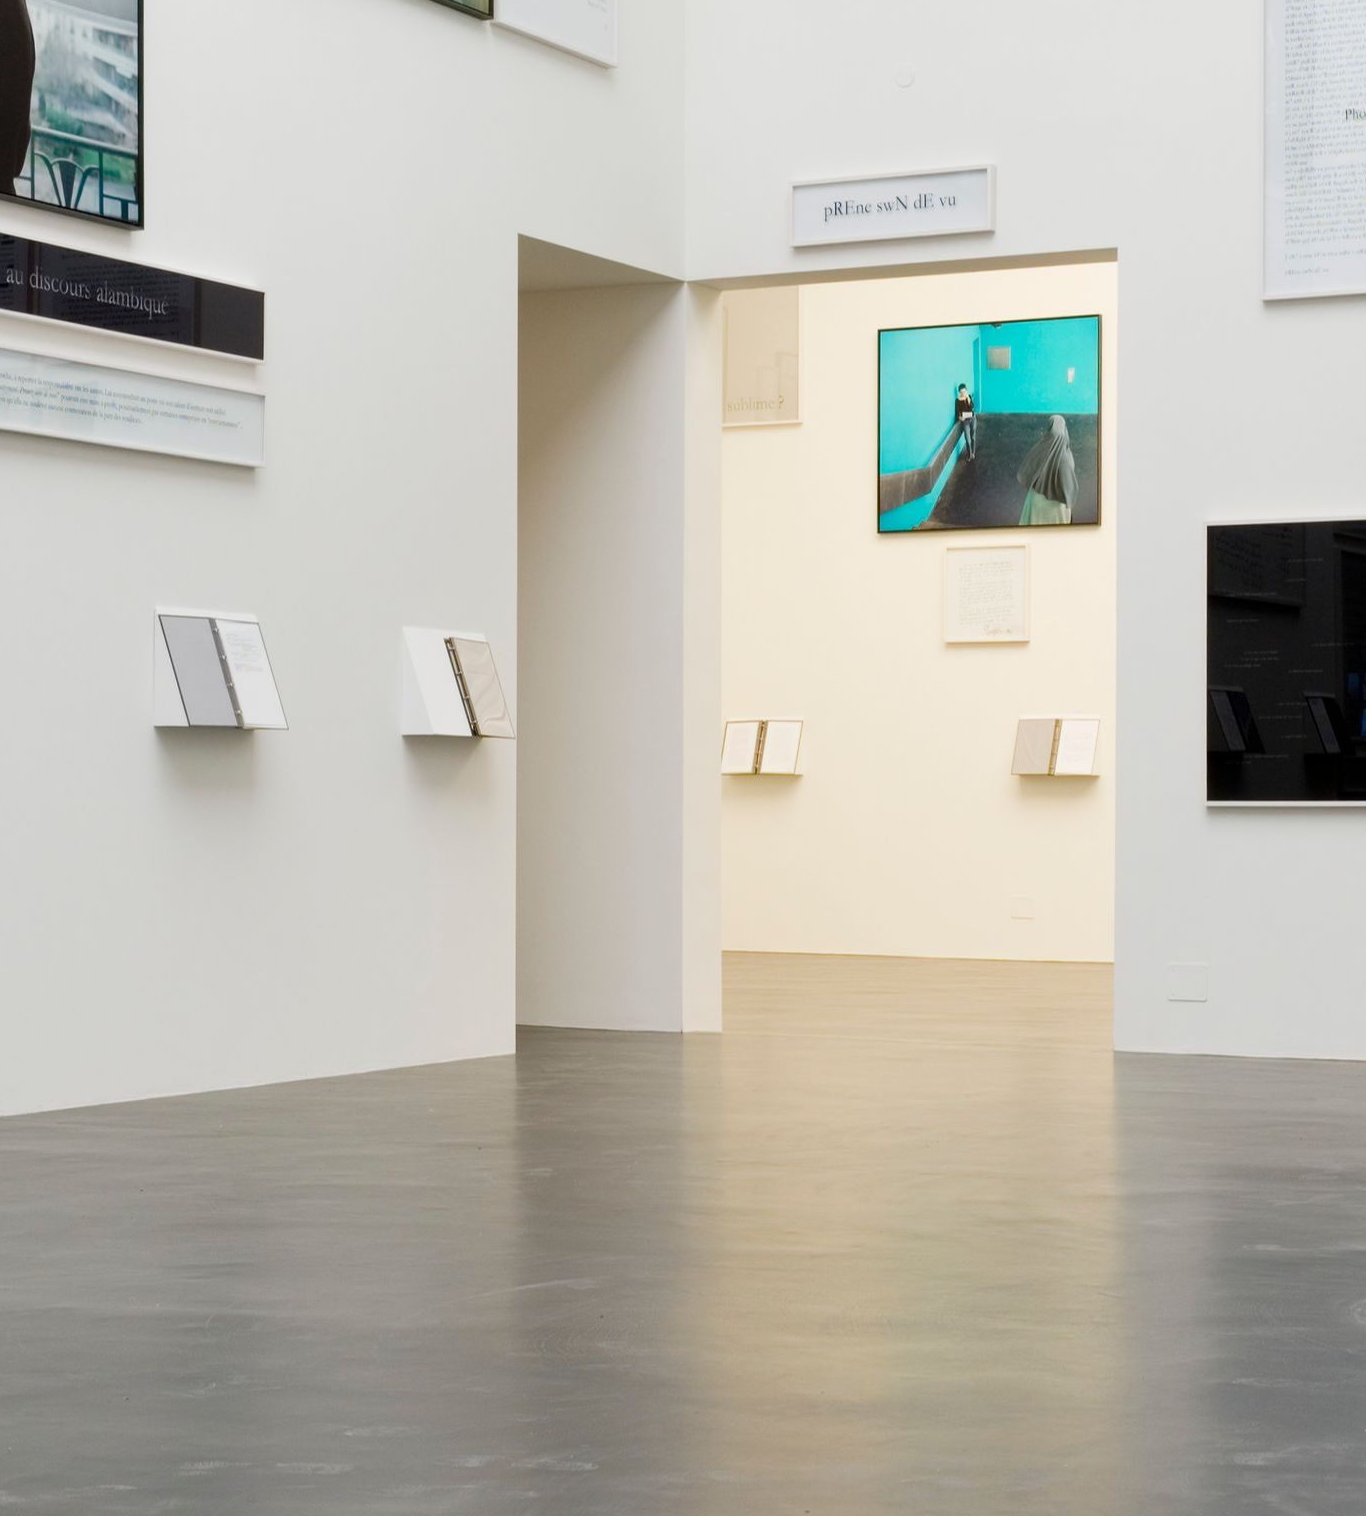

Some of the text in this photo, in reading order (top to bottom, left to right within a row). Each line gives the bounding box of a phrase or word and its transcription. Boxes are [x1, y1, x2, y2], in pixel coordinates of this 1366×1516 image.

[939, 194, 957, 207] vu
[6, 266, 24, 285] au
[29, 265, 91, 300] discours
[96, 280, 170, 320] alambiqué
[727, 396, 775, 412] sublime
